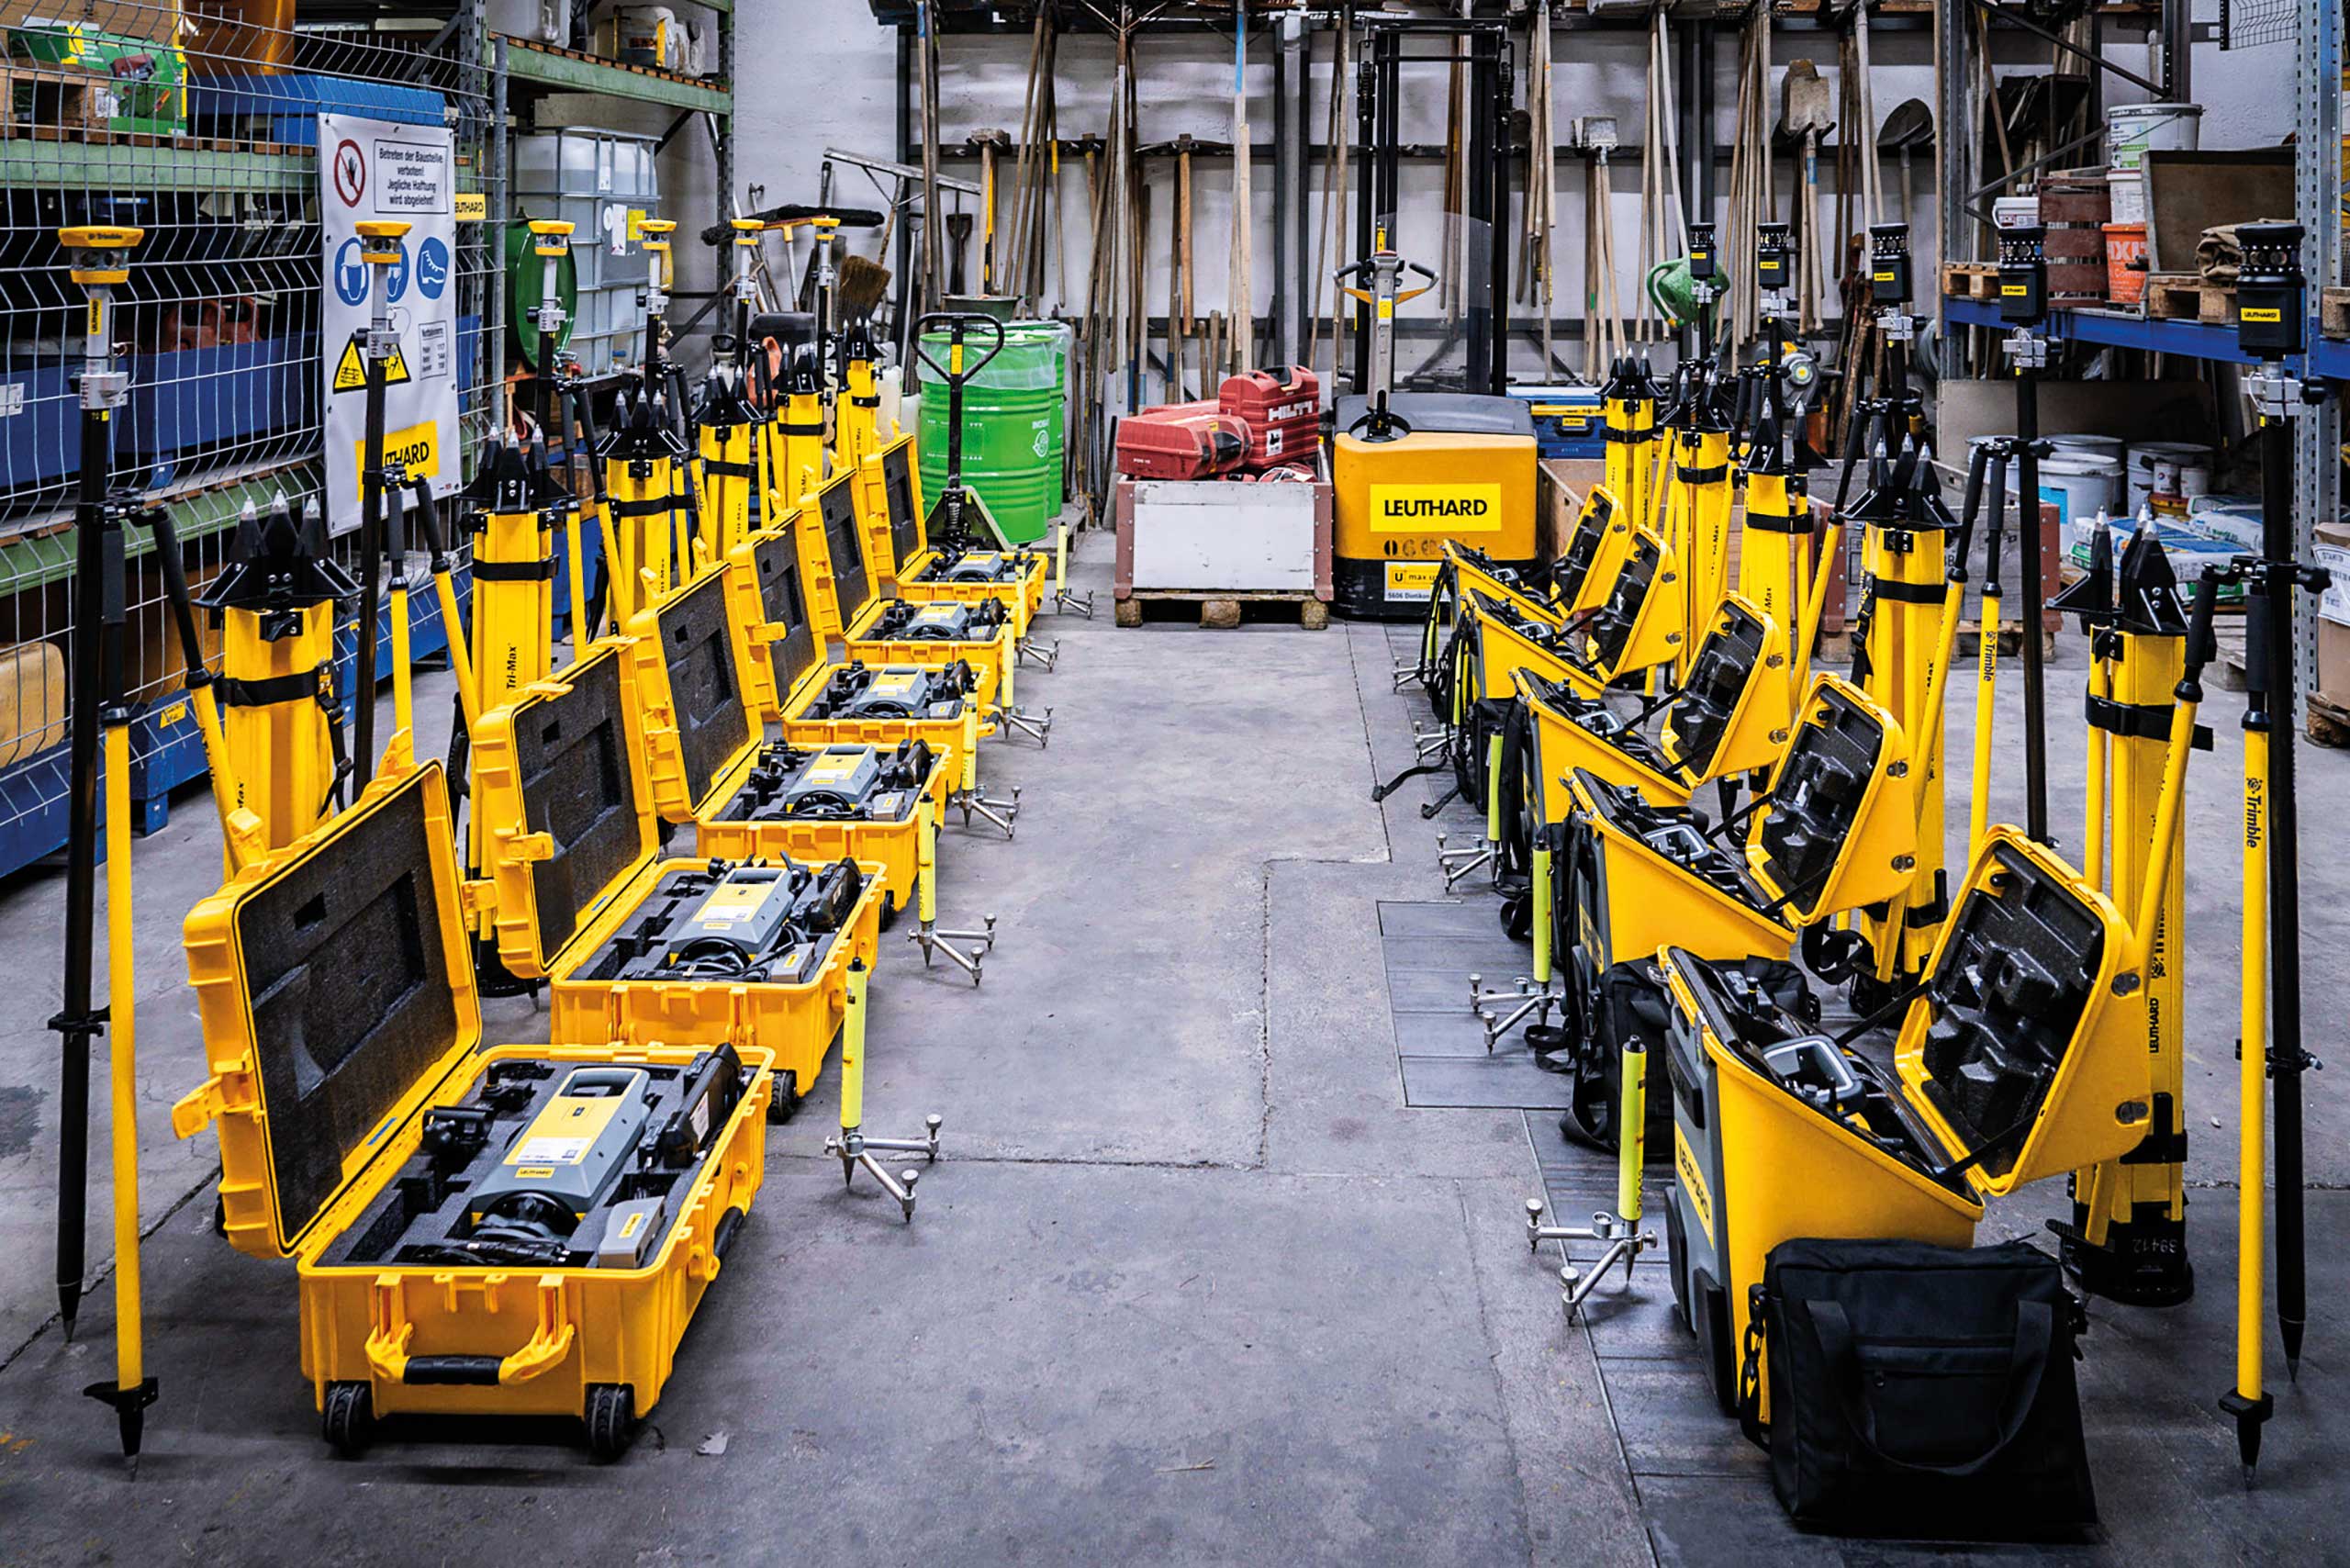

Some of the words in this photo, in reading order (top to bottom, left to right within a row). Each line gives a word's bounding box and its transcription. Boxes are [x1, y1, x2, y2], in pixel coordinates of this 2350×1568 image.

[379, 148, 403, 161] Betreten
[405, 151, 414, 161] der
[416, 151, 442, 163] Baustelle
[387, 178, 411, 192] Jegliche
[412, 180, 436, 194] Haftung
[389, 195, 402, 205] wird
[455, 201, 484, 212] EUTHARD
[1268, 400, 1313, 422] HILTI
[1384, 499, 1488, 516] LEUTHARD
[1395, 573, 1403, 582] U
[506, 645, 517, 689] Tri-Max
[1984, 644, 1996, 681] Trimble
[2246, 795, 2261, 848] Trimble
[2149, 997, 2159, 1054] LEUTHARD
